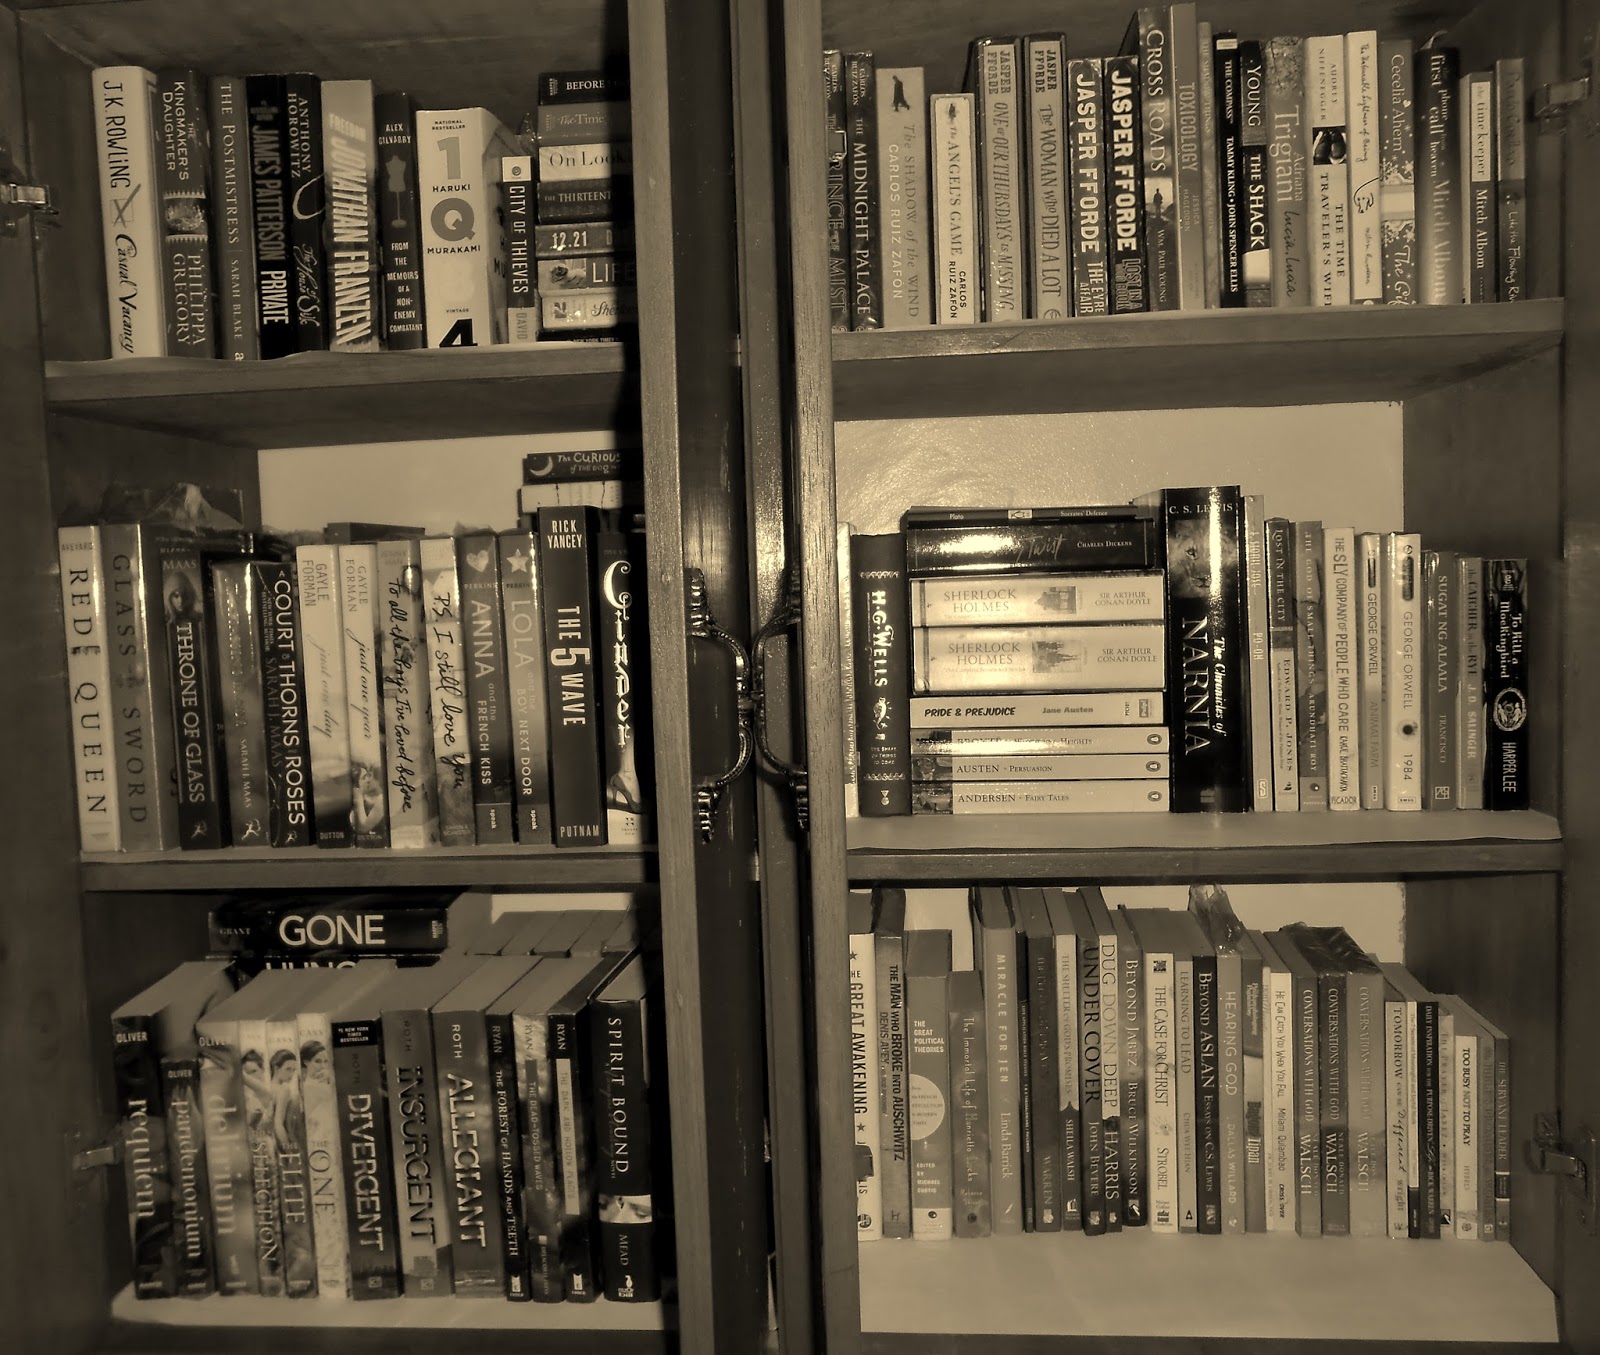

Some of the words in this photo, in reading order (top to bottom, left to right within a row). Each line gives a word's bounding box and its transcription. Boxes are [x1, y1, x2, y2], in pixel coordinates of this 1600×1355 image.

[566, 79, 605, 91] BEFORE
[988, 52, 998, 94] FFORDE
[1000, 51, 1012, 94] JASPER
[1035, 50, 1045, 92] FFORDE
[1047, 50, 1057, 90] JASPER
[1146, 30, 1164, 97] CROSS
[220, 83, 232, 115] THE
[1076, 74, 1096, 160] JASPER
[1112, 70, 1132, 159] JASPER
[1246, 66, 1262, 127] YOUNG
[162, 92, 176, 171] DAUGHTER
[174, 81, 189, 180] KINGMAKER'S
[252, 126, 280, 175] JAMES
[288, 93, 300, 178] HOROWITZ
[299, 97, 310, 172] ANTHONY
[385, 123, 404, 133] ALEX
[1149, 101, 1166, 172] ROADS
[1179, 82, 1197, 172] TOXICOLOGY
[437, 136, 461, 180] 1
[889, 145, 900, 202] CARLOS
[1226, 136, 1235, 168] TAMMY
[1250, 154, 1262, 181] THE
[1475, 132, 1485, 175] keeper
[222, 124, 239, 244] POSTMISTRESS
[432, 184, 471, 193] HARUKI
[509, 185, 526, 214] CITY
[854, 143, 869, 240] MIDNIGHT
[904, 156, 917, 223] SHADOW
[256, 182, 286, 261] PATTERSON
[430, 197, 476, 241] Q
[891, 209, 901, 241] RUIZ
[1080, 168, 1100, 252] FFORDE
[1114, 165, 1136, 251] FFORDE
[1250, 184, 1265, 248] SHACK
[1320, 173, 1331, 264] TRAVELER'S
[1335, 204, 1344, 232] THE
[391, 242, 409, 251] FROM
[427, 245, 481, 255] MURAKAMI
[512, 239, 528, 294] THIEVES
[1336, 237, 1345, 277] TIME
[232, 260, 240, 298] SARAH
[260, 270, 288, 324] PRIVATE
[387, 271, 419, 281] MEMOIRS
[856, 249, 870, 314] PALACE
[892, 249, 903, 298] ZAFÓN
[959, 271, 967, 308] CARLOS
[172, 253, 190, 345] GREGORY
[188, 254, 206, 346] PHILIPPA
[232, 304, 243, 340] BLAKE
[334, 251, 372, 346] FRANZEN
[389, 323, 423, 333] COMBATANT
[547, 533, 582, 549] YANCEY
[552, 519, 576, 533] RICK
[163, 560, 197, 569] MAAS
[302, 560, 317, 607] FORMAN
[316, 563, 330, 601] GAYLE
[346, 559, 357, 612] FORMAN
[358, 566, 369, 604] GAYLE
[273, 579, 295, 652] COURT
[943, 588, 1017, 602] SHERLOCK
[953, 602, 1010, 613] HOLMES
[1334, 577, 1346, 622] COMPANY
[1368, 593, 1378, 631] GEORGE
[471, 600, 494, 678] ANNA
[511, 600, 534, 669] LOLA
[557, 606, 581, 640] THE
[1404, 611, 1413, 660] GEORGE
[176, 623, 197, 707] THRONE
[948, 642, 1020, 654] SHERLOCK
[957, 654, 1013, 665] HOLMES
[1368, 634, 1378, 676] ORWELL
[279, 661, 299, 747] THORNS
[561, 673, 586, 726] WAVE
[1064, 705, 1094, 714] Austen
[1181, 616, 1211, 756] NARNIA
[1212, 662, 1226, 721] Chronicles
[1404, 663, 1414, 709] ORWELL
[477, 700, 490, 754] FRENCH
[924, 707, 952, 717] PRIDE
[965, 706, 1016, 716] PREJUDICE
[1468, 711, 1476, 758] SALINGER
[73, 682, 107, 813] QUEEN
[122, 707, 147, 823] SWORD
[480, 756, 492, 785] KISS
[956, 764, 1000, 773] AUSTEN
[1404, 754, 1413, 780] 1984
[185, 742, 204, 803] GLASS
[285, 756, 305, 825] ROSES
[957, 793, 1016, 803] ANDERSEN
[560, 825, 599, 838] PUTNAM
[278, 914, 386, 946] GONE
[889, 965, 898, 982] THE
[890, 983, 900, 1009] MAN
[996, 955, 1007, 1017] MIRACLE
[1125, 960, 1138, 1021] BEYOND
[850, 982, 865, 1031] GREAT
[1180, 971, 1189, 1024] LEARNING
[1199, 972, 1212, 1027] BEYOND
[116, 1031, 148, 1043] OLIVER
[452, 1023, 462, 1059] ROTH
[492, 1025, 502, 1053] RYAN
[557, 1023, 566, 1050] RYAN
[879, 1012, 888, 1042] DENIS
[914, 1037, 945, 1045] POLITICAL
[1224, 991, 1236, 1057] HEARING
[1303, 989, 1313, 1069] CONVERSATIONS
[1327, 988, 1339, 1069] CONVERSATIONS
[1392, 1008, 1403, 1078] TOMORROW
[168, 1069, 193, 1078] OLIVER
[607, 1018, 625, 1087] SPIRIT
[852, 1033, 868, 1114] AWAKENING
[891, 1033, 902, 1073] BROKE
[914, 1046, 944, 1054] THEORIES
[1200, 1030, 1215, 1089] ASLAN
[1461, 1048, 1471, 1066] TOO
[1104, 1063, 1118, 1109] DEEP
[1461, 1067, 1471, 1088] BUSY
[497, 1088, 509, 1135] FOREST
[892, 1096, 905, 1162] AUSCHWITZ
[1462, 1119, 1471, 1147] PRAY
[126, 1099, 155, 1218] requiem
[396, 1066, 437, 1244] INSURGENT
[611, 1098, 629, 1174] BOUND
[1128, 1123, 1138, 1195] WILKINSON
[171, 1098, 201, 1258] pandemonium
[308, 1149, 336, 1215] ONE
[347, 1093, 384, 1252] DIVERGENT
[446, 1072, 486, 1248] ALLEGIANT
[502, 1152, 514, 1195] HANDS
[1001, 1142, 1010, 1180] Barrick
[1104, 1131, 1119, 1200] HARRIS
[1156, 1147, 1169, 1190] STROBEL
[1299, 1135, 1312, 1195] WALSCH
[1325, 1133, 1337, 1192] WALSCH
[508, 1217, 518, 1257] TEETH
[618, 1235, 629, 1266] MEAD
